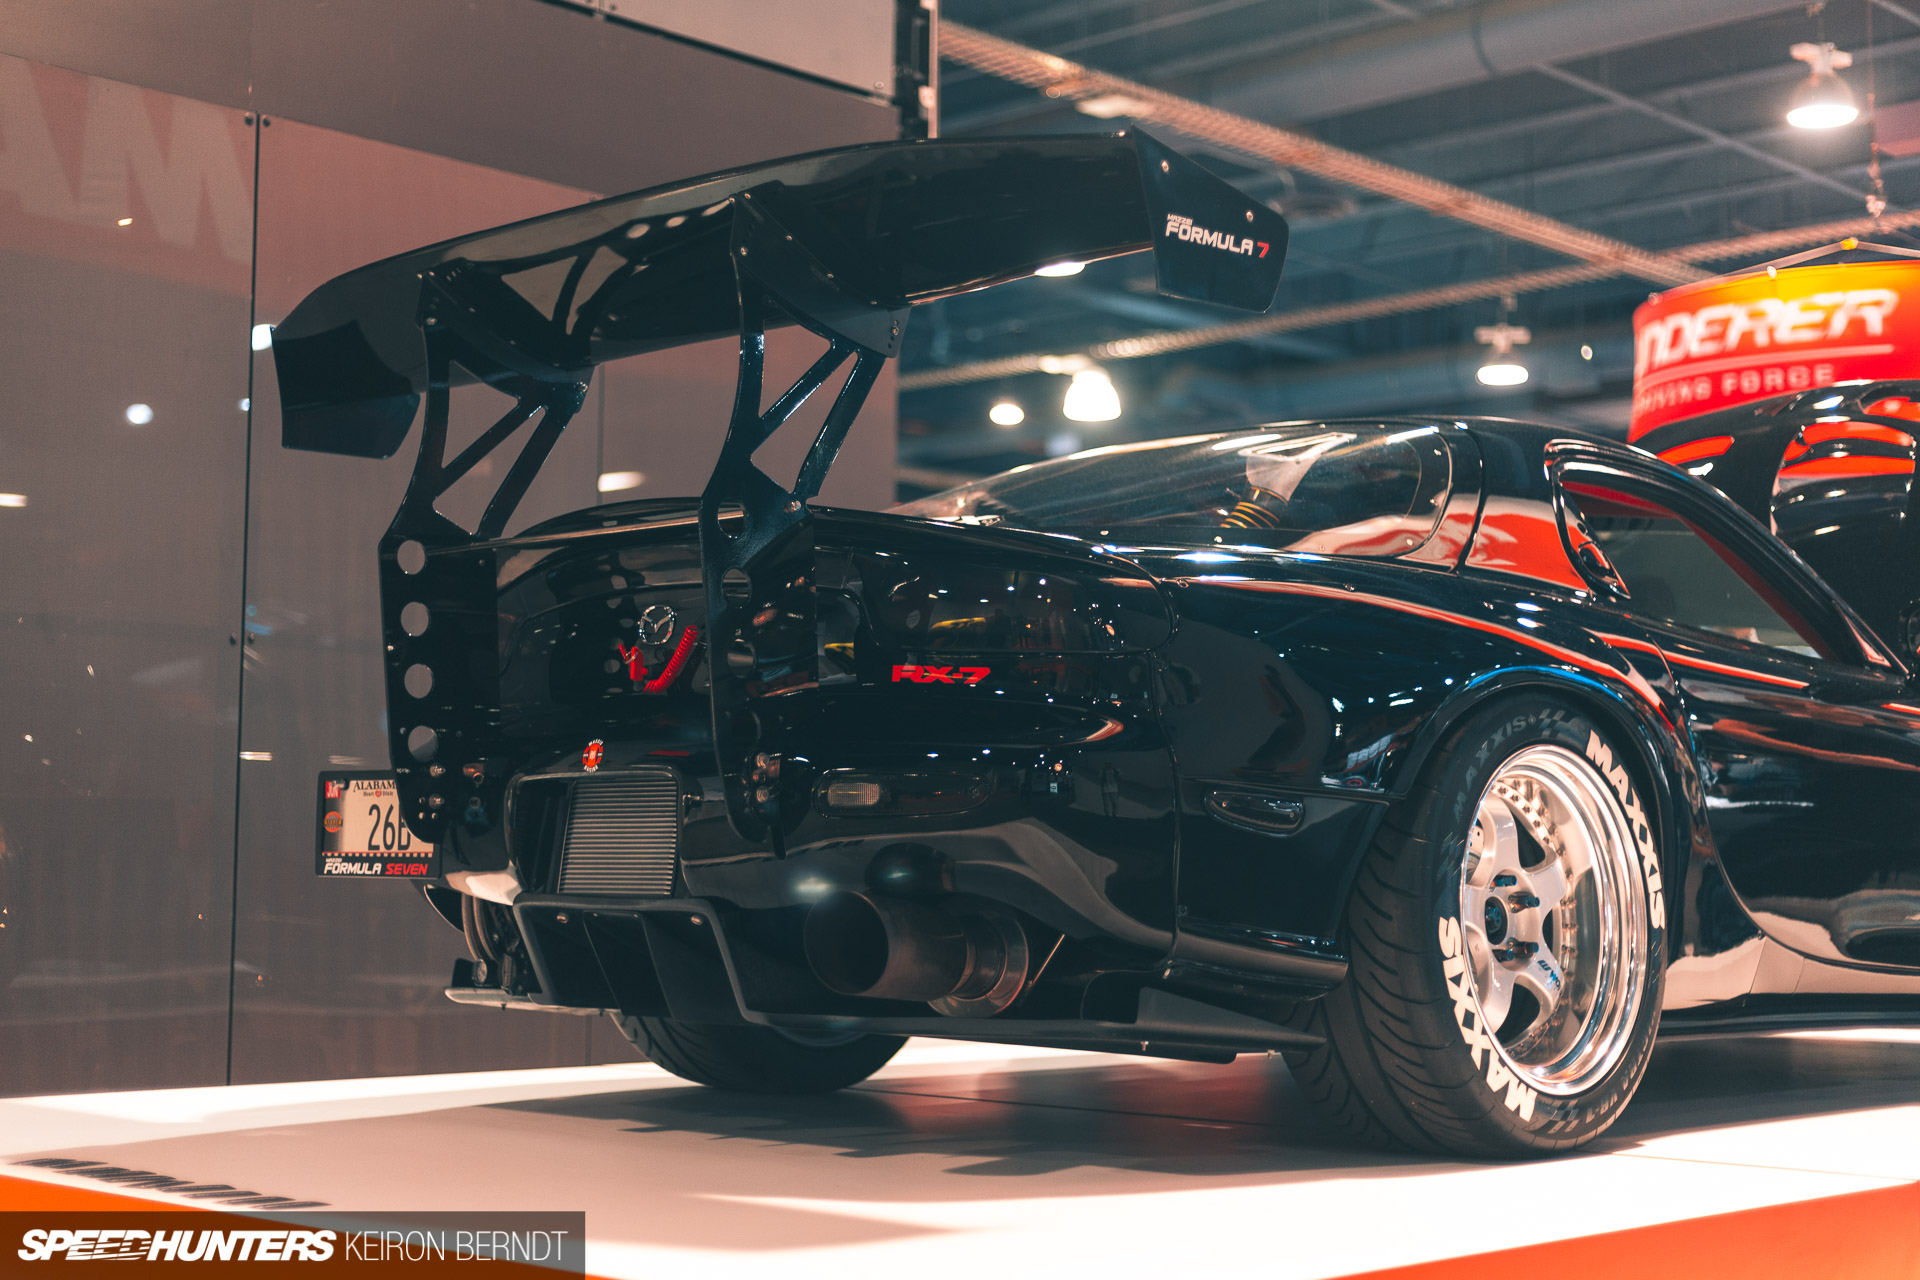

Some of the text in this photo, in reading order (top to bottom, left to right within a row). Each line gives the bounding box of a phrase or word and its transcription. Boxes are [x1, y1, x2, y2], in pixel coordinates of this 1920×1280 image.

[1165, 221, 1270, 258] FORMULA 7
[1721, 363, 1835, 396] FORCE
[891, 664, 990, 684] RX-7
[353, 780, 397, 792] ALABAM
[1585, 729, 1666, 930] MAXXIS
[324, 863, 428, 875] FORMULA SEVEN
[1438, 916, 1538, 1122] MAXXIS
